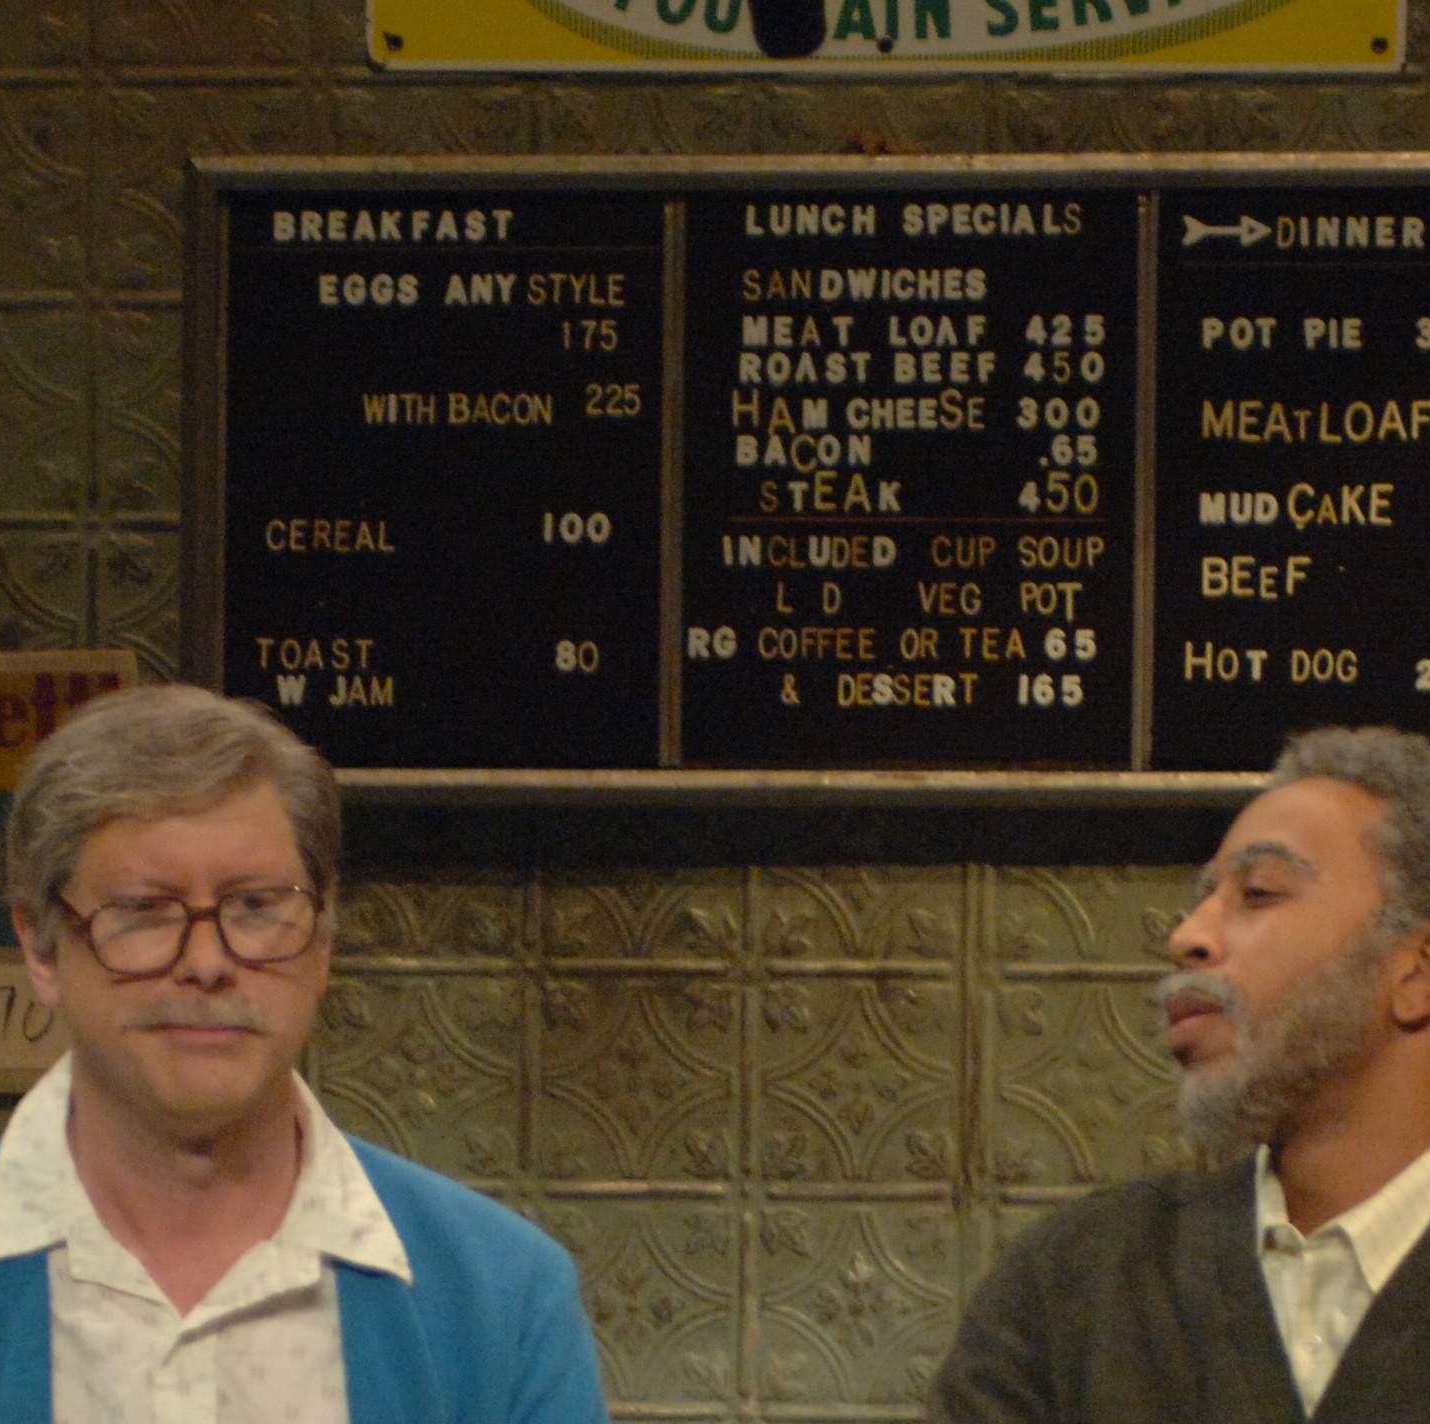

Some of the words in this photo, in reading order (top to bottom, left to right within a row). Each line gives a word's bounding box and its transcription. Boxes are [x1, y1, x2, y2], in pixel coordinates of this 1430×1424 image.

[272, 209, 515, 242] BREAKFAST
[745, 203, 877, 236] LUNCH
[902, 203, 1082, 236] SPECIALS
[1276, 216, 1426, 248] DINNER
[318, 273, 420, 306] EGGS
[444, 273, 517, 306] ANY
[526, 273, 625, 306] STYLE
[741, 268, 987, 301] SANDWICHES
[561, 319, 619, 351] 175
[741, 315, 855, 347] MEAT
[888, 315, 988, 347] LOAF
[1024, 314, 1105, 347] 425
[1201, 317, 1277, 350] POT
[1303, 317, 1363, 350] PIE
[738, 351, 871, 385] ROAST
[893, 351, 997, 385] BEEF
[1022, 351, 1105, 385] 450
[362, 392, 438, 424] WITH
[448, 392, 553, 425] BACON
[585, 383, 642, 416] 225
[731, 388, 829, 434] HAM
[846, 388, 986, 430] CHEESE
[1015, 397, 1101, 430] 300
[735, 433, 871, 473] BACON
[759, 469, 902, 513] STEAK
[1018, 471, 1100, 514] 450
[1199, 492, 1279, 526] MUD
[265, 518, 396, 553] CEREAL
[542, 511, 612, 544] 100
[722, 535, 897, 568] INCLUDED
[930, 535, 997, 568] CUP
[1017, 535, 1105, 568] SOUP
[1201, 556, 1312, 600] BEEF
[918, 581, 982, 616] VEG
[1019, 581, 1084, 622] POT
[255, 637, 373, 671] TOAST
[554, 640, 600, 673] 80
[687, 626, 737, 660] RG
[758, 626, 877, 660] COFFEE
[899, 626, 938, 660] OR
[959, 626, 1027, 660] TEA
[1043, 626, 1097, 660] 65
[1183, 640, 1268, 683] HOT
[1291, 648, 1358, 683] DOG
[276, 674, 307, 706] W
[328, 674, 395, 706] JAM
[780, 673, 800, 705] &
[837, 673, 979, 706] DESSERT
[1017, 673, 1084, 706] 165
